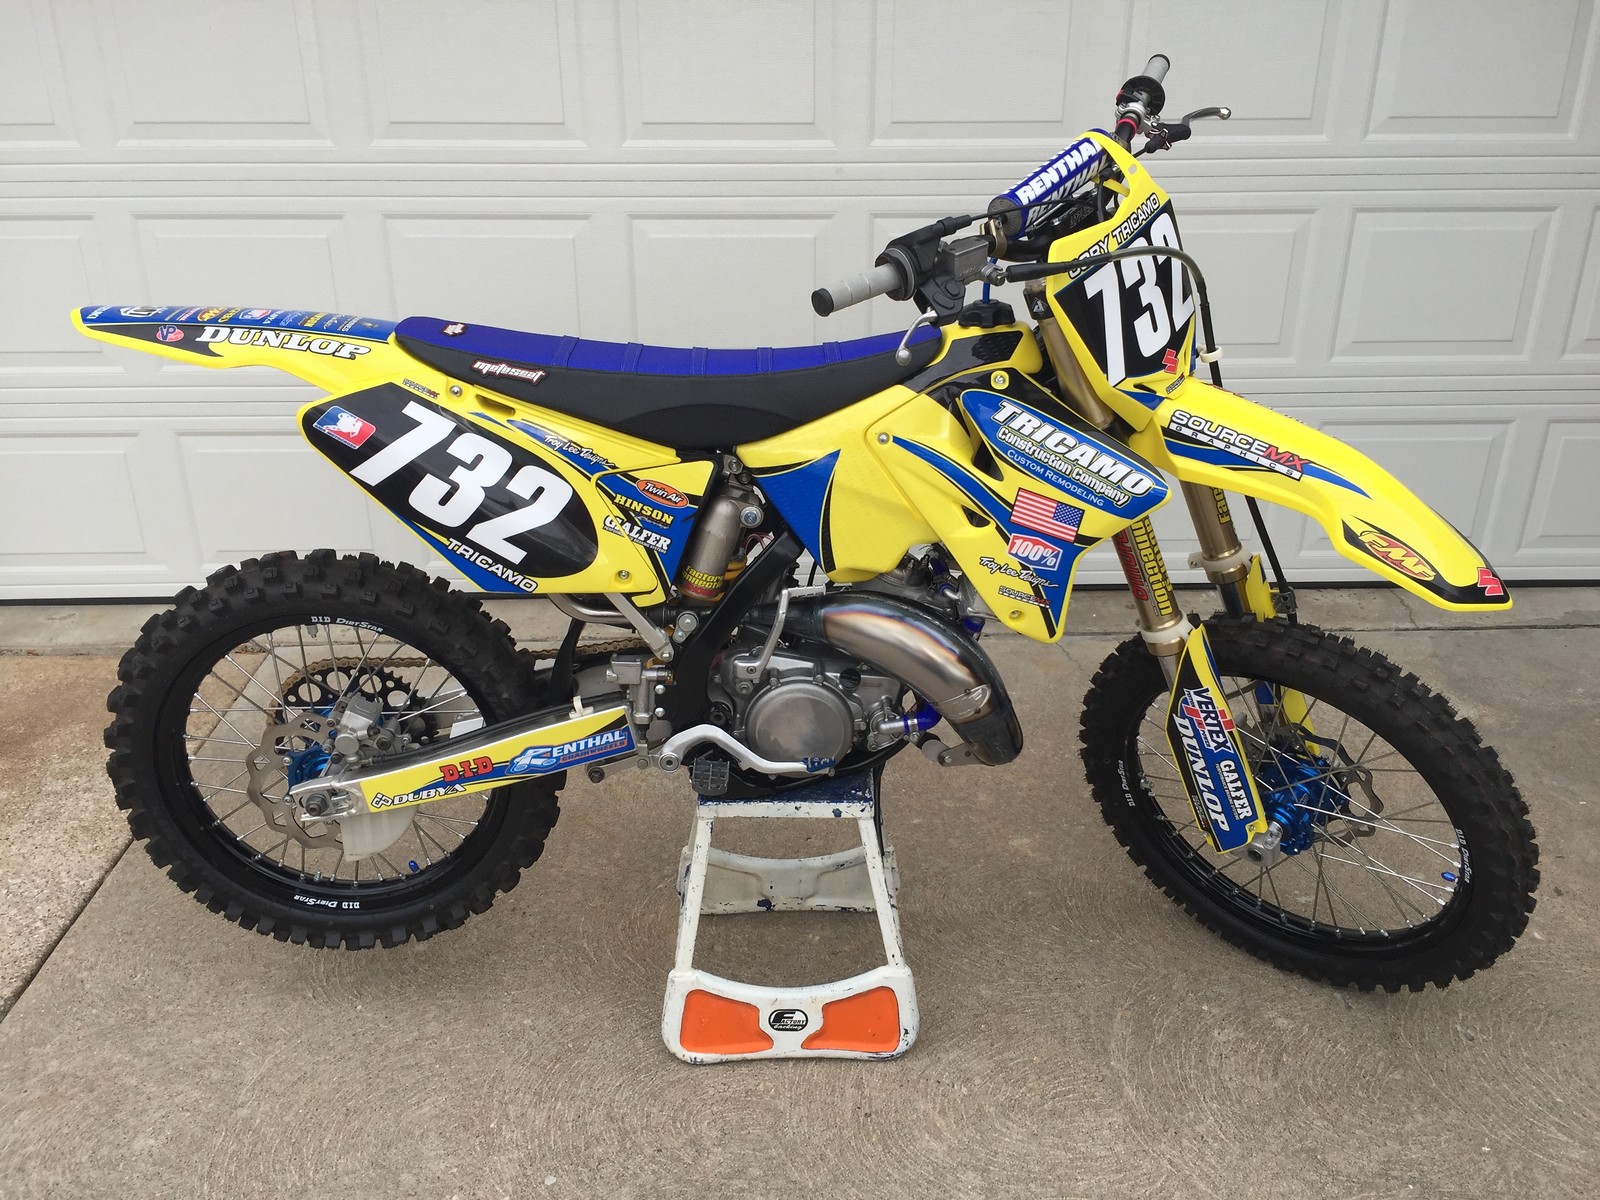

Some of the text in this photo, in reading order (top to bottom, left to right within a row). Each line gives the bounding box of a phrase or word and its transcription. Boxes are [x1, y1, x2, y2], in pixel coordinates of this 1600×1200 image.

[1112, 192, 1160, 246] TRICAMO
[1084, 212, 1194, 387] 732
[195, 326, 371, 359] DUNLOP
[544, 435, 563, 450] Troy
[563, 442, 579, 454] Lee
[992, 401, 1154, 496] TRICAMO
[1175, 425, 1294, 476] GRAPHICS
[349, 400, 574, 565] 732
[644, 482, 684, 504] Twin Air
[1007, 450, 1104, 506] CUSTOM REMODELING
[604, 515, 671, 551] GALFER
[613, 494, 674, 525] HINSON
[446, 537, 538, 592] TRICAMO
[980, 557, 1000, 574] Troy
[1000, 564, 1018, 577] Lee
[1010, 539, 1059, 566] 100%
[1130, 519, 1173, 616] nnection
[1358, 532, 1437, 578] FMF
[1192, 687, 1232, 752] VERTEX
[393, 783, 466, 806] DUBYA
[1172, 714, 1230, 832] DUNLOP
[1220, 760, 1253, 820] GALFER
